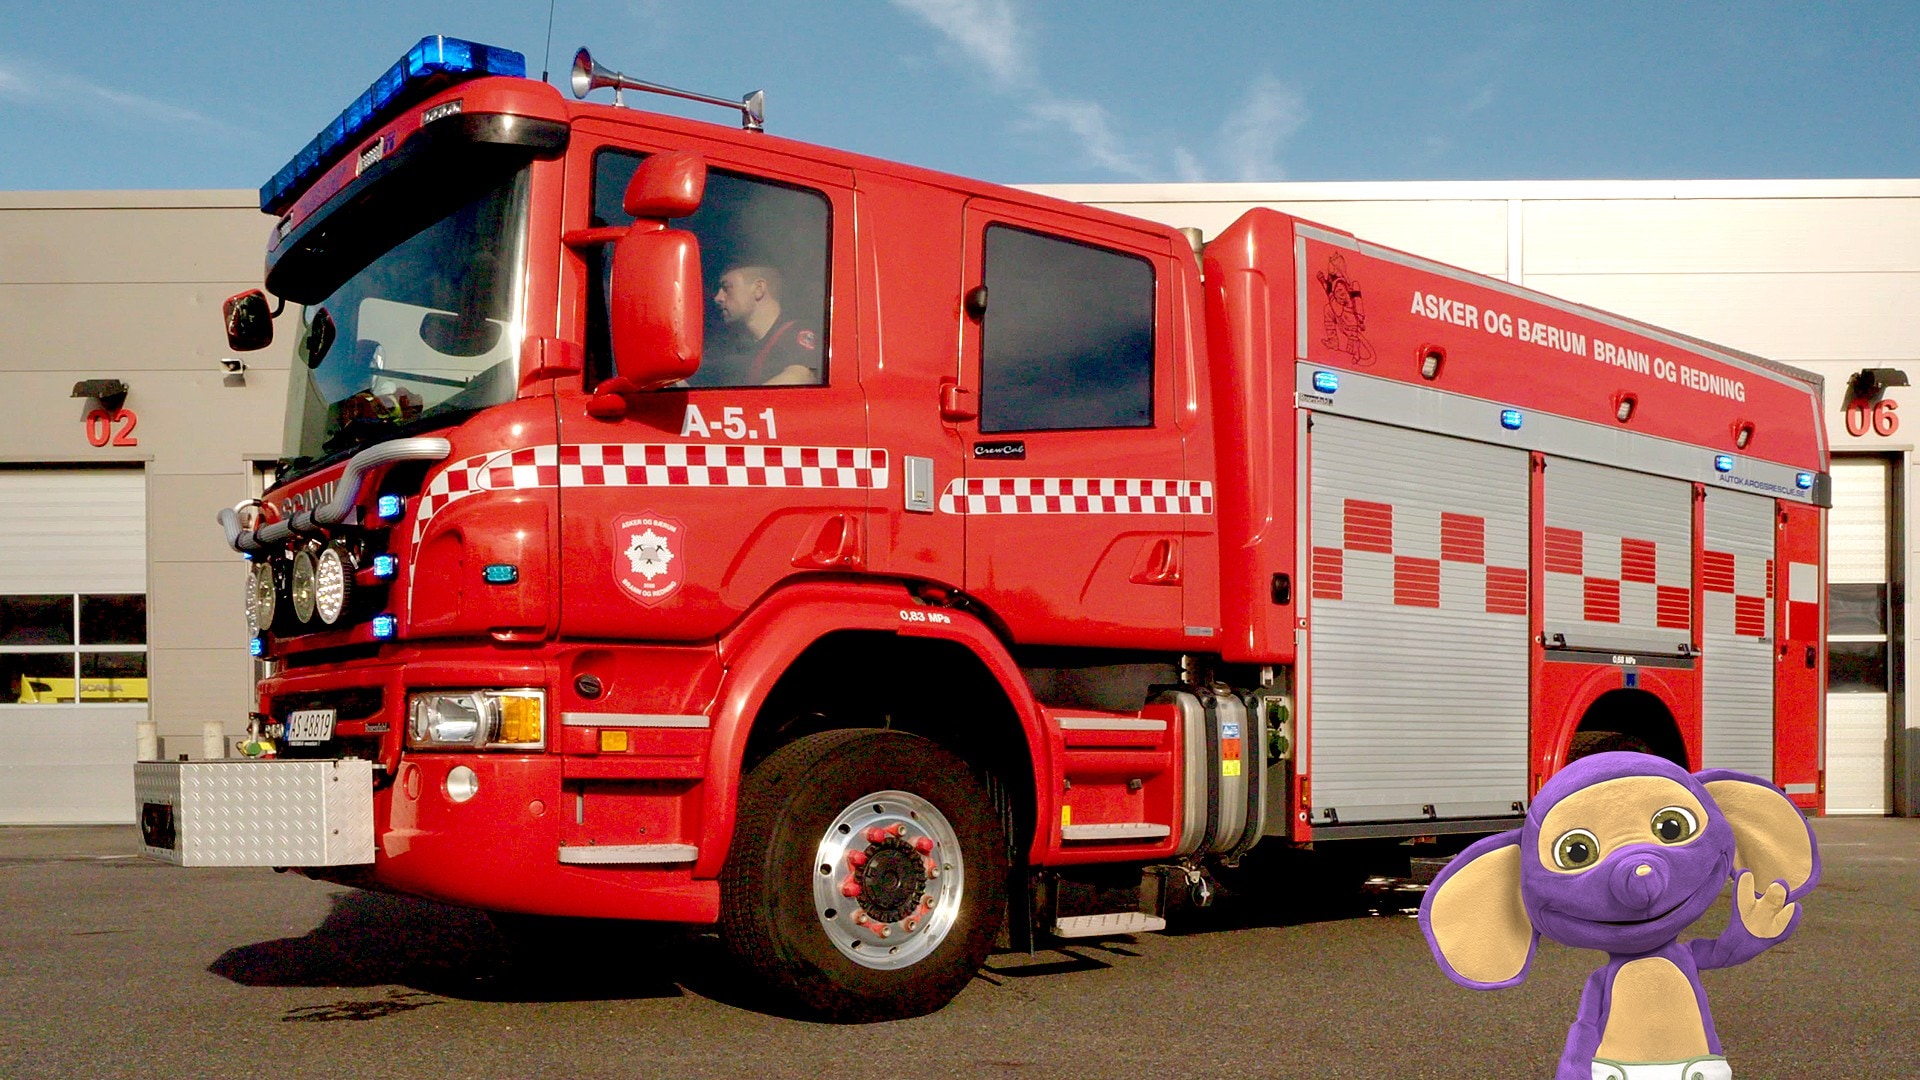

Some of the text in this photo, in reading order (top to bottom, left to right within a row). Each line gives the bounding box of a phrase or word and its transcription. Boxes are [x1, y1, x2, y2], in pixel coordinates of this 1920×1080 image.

[1411, 291, 1745, 403] ASKER OG BÆRUM BRANN OG REDNING
[86, 408, 138, 447] 02
[680, 404, 777, 440] A-5.1
[1845, 398, 1899, 437] 06
[282, 479, 341, 520] SCANI
[621, 519, 643, 529] ASKER
[642, 518, 653, 526] OG
[899, 609, 951, 625] 0,83 MPa
[290, 713, 331, 739] AS 48819
